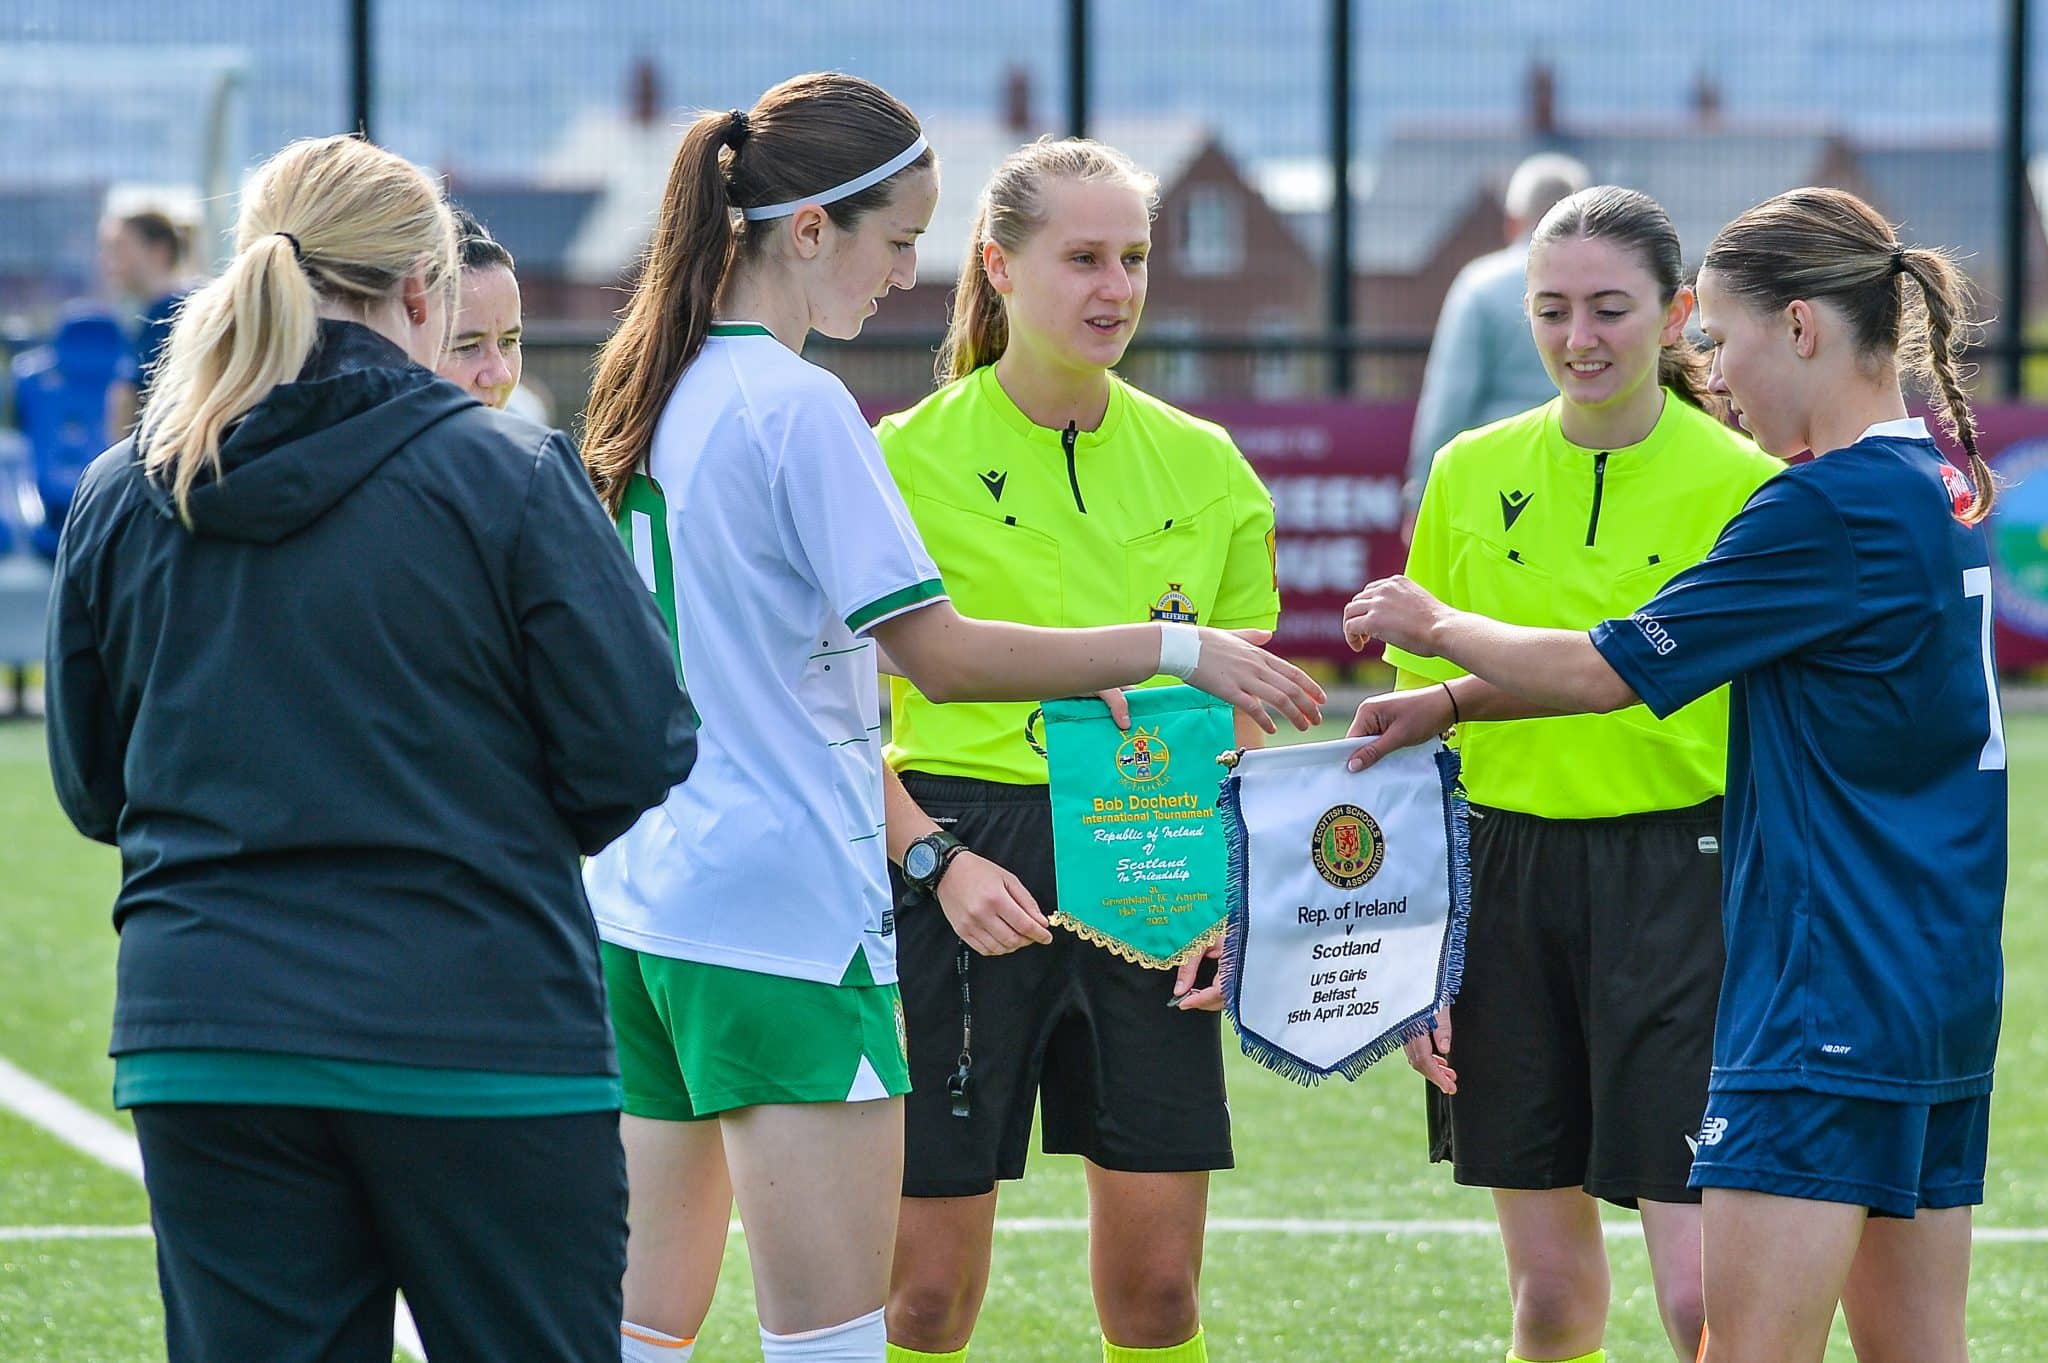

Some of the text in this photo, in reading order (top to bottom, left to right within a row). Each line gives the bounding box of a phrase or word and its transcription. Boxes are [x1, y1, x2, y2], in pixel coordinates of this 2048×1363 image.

[1093, 792, 1198, 812] Bob Docherty
[1082, 807, 1214, 825] International Tournament
[1314, 806, 1381, 843] SCOTTISH SCHOOLS
[1093, 825, 1205, 845] Republic of Ireland
[1116, 856, 1188, 871] Scotland
[1313, 842, 1384, 887] FOOTBALL ASSOCIATION
[1117, 868, 1190, 883] In Friendship
[1298, 896, 1407, 927] Rep. of Ireland
[1312, 938, 1381, 960] Scotland
[1310, 968, 1368, 986] U/15 Girls
[1312, 986, 1358, 1004] Belfast
[1287, 1001, 1380, 1024] 15th April 2025
